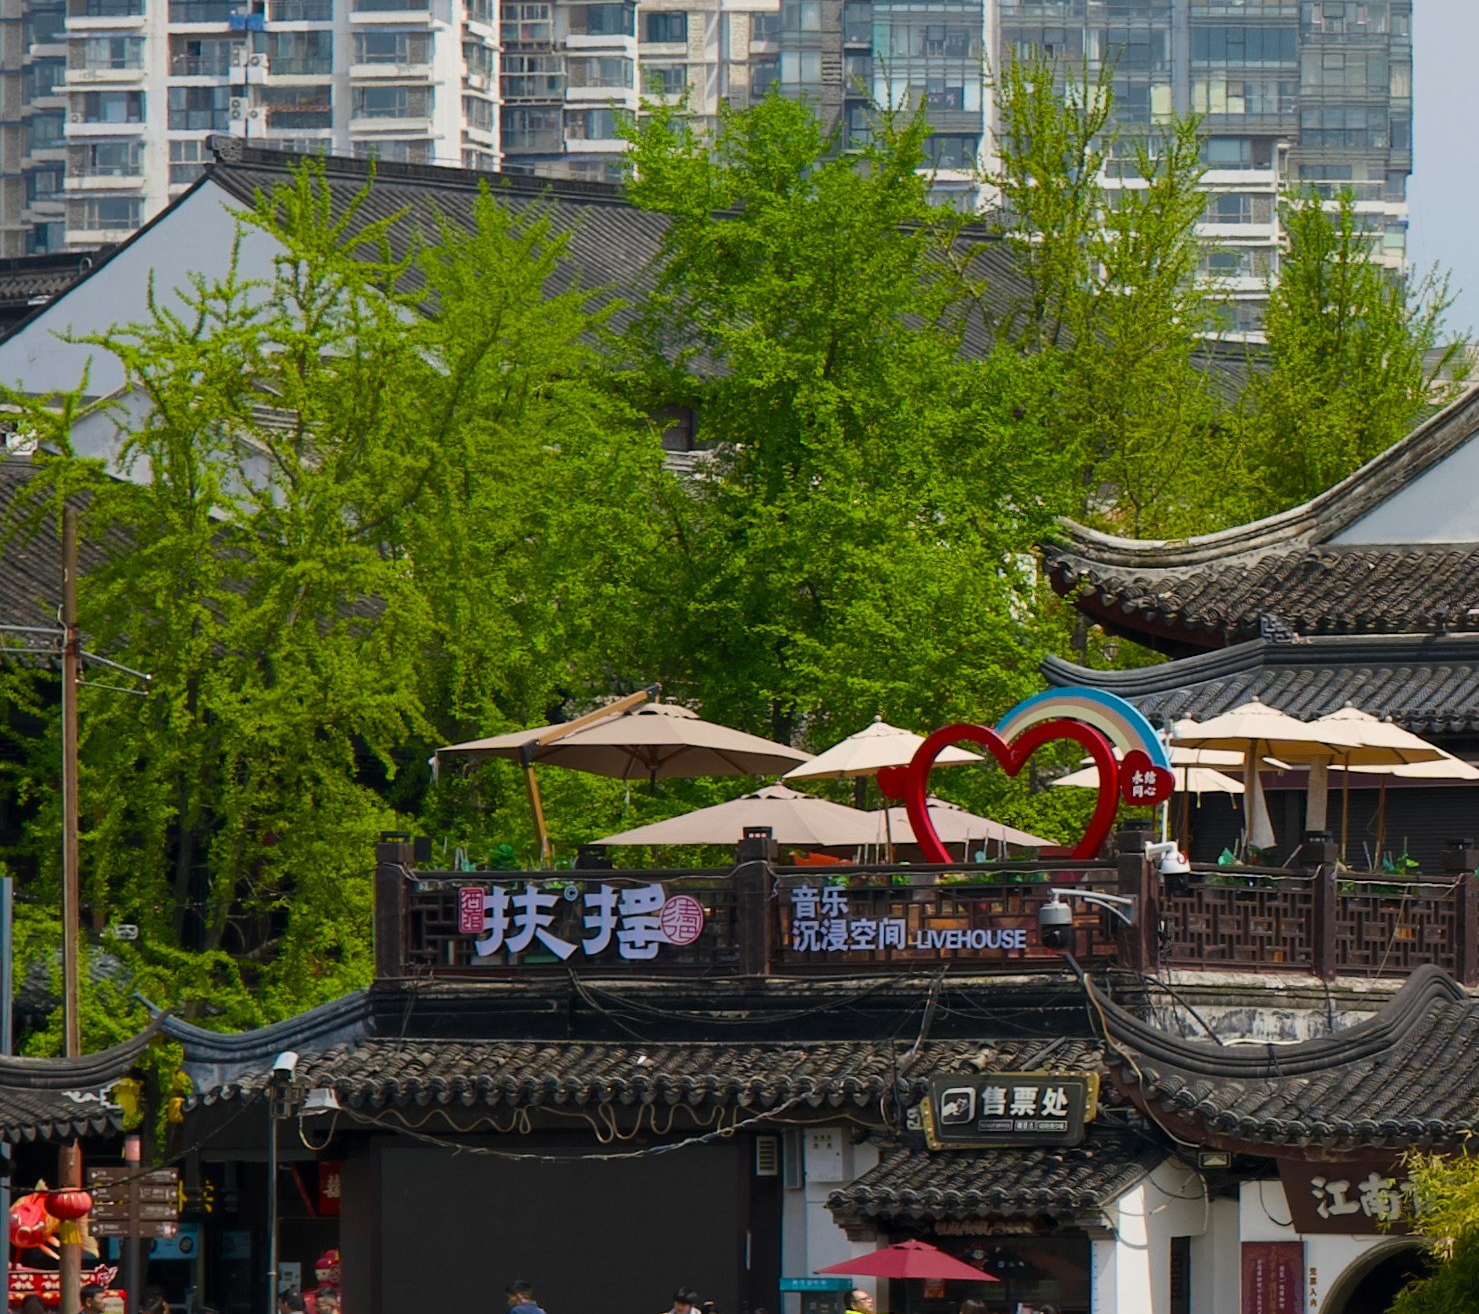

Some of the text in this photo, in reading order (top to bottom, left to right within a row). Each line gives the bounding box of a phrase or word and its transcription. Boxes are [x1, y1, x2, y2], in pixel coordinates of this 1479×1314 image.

[791, 885, 849, 918] 音乐
[791, 917, 906, 952] 沉浸空间
[916, 929, 1026, 950] LIVEHOUSE
[981, 1086, 1069, 1117] 售票处
